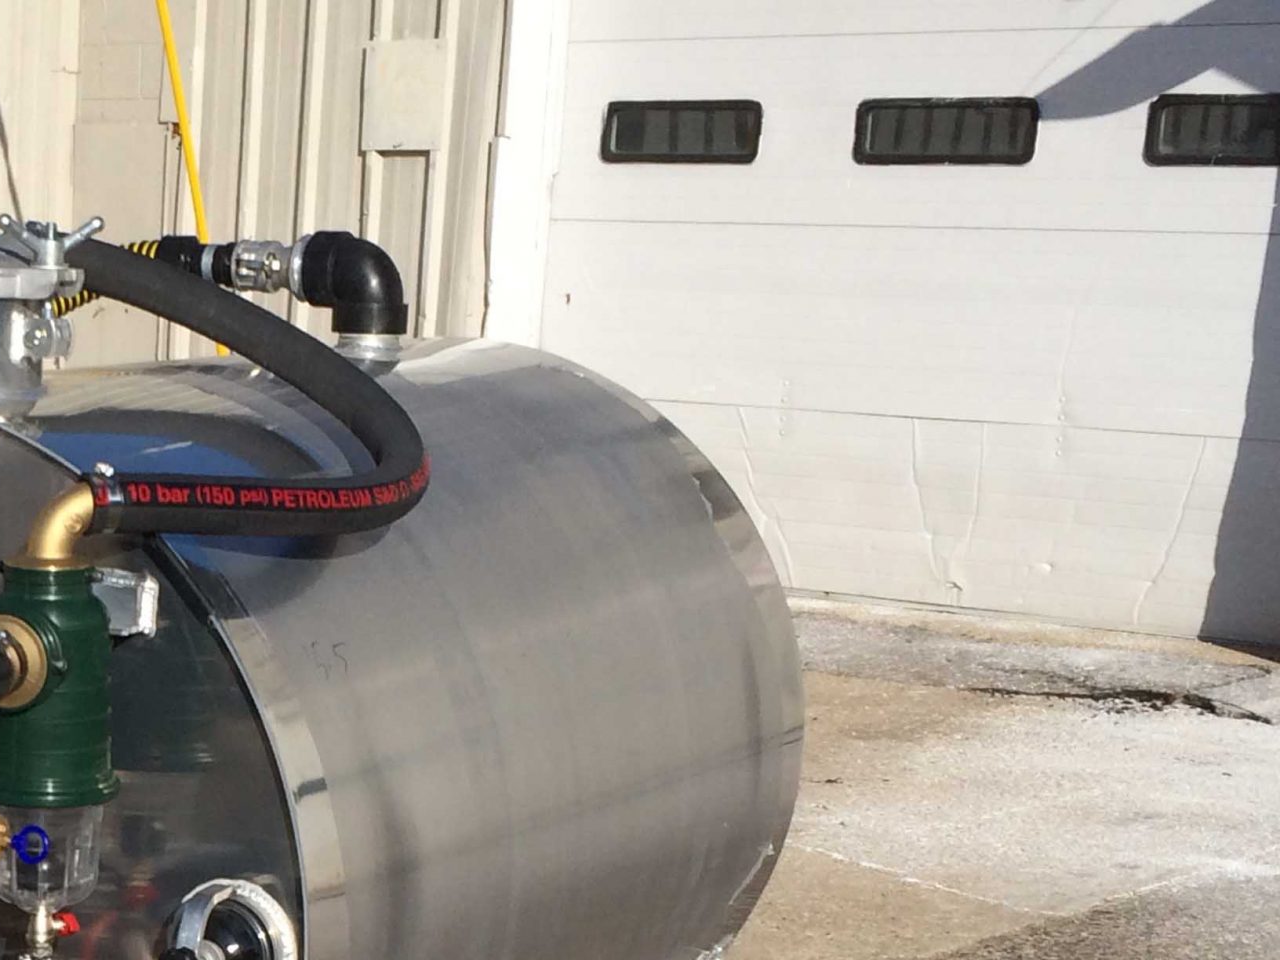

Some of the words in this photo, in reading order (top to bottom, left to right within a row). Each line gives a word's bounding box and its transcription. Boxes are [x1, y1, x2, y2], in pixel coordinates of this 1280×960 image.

[128, 482, 151, 503] 10
[156, 483, 190, 504] bar
[196, 485, 236, 506] (150
[271, 487, 372, 510] PETROLEUM
